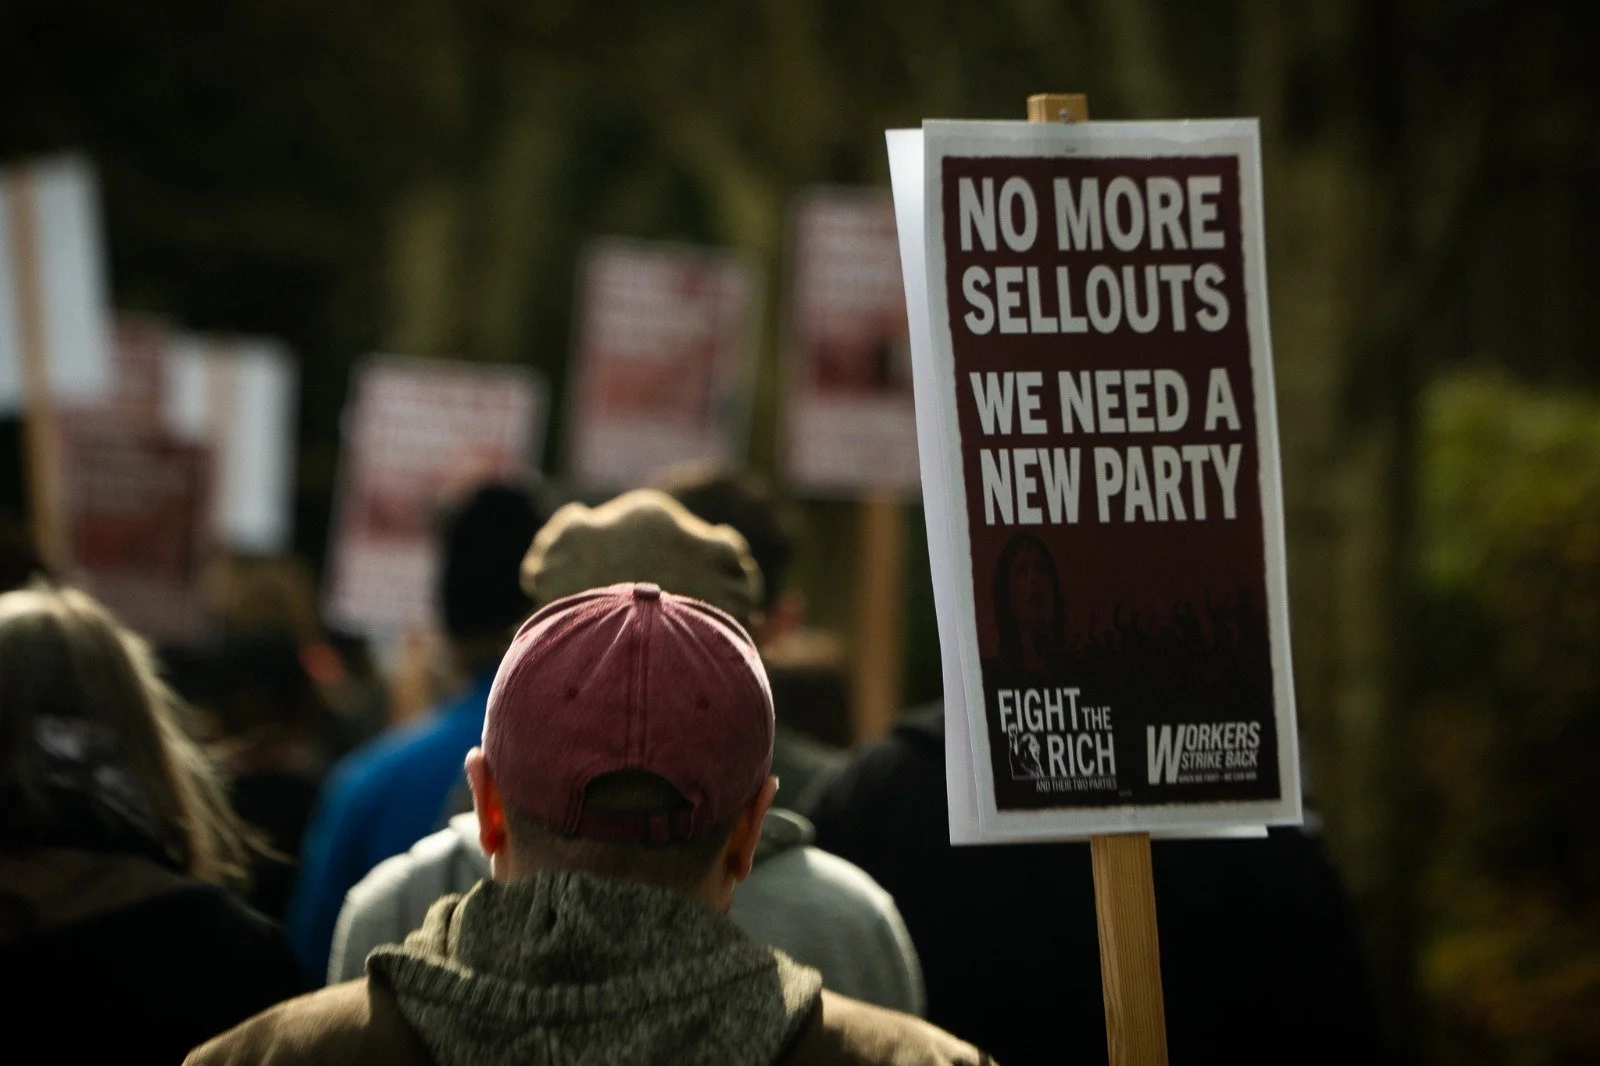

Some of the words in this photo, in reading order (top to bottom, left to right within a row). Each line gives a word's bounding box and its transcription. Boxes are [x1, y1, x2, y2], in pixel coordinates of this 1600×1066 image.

[958, 176, 1038, 252] NO
[1053, 175, 1225, 252] MORE
[962, 263, 1230, 335] SELLOUTS
[968, 371, 1048, 435] WE
[1057, 369, 1190, 434] NEED
[1204, 368, 1242, 431] A
[979, 447, 1081, 525] NEW
[1093, 443, 1243, 523] PARTY
[998, 687, 1080, 733] FIGHT
[1081, 706, 1112, 731] THE
[1046, 732, 1116, 777] RICH
[1146, 721, 1260, 785] WORKERS
[1181, 751, 1221, 770] STRIKE
[1224, 749, 1257, 768] BACK
